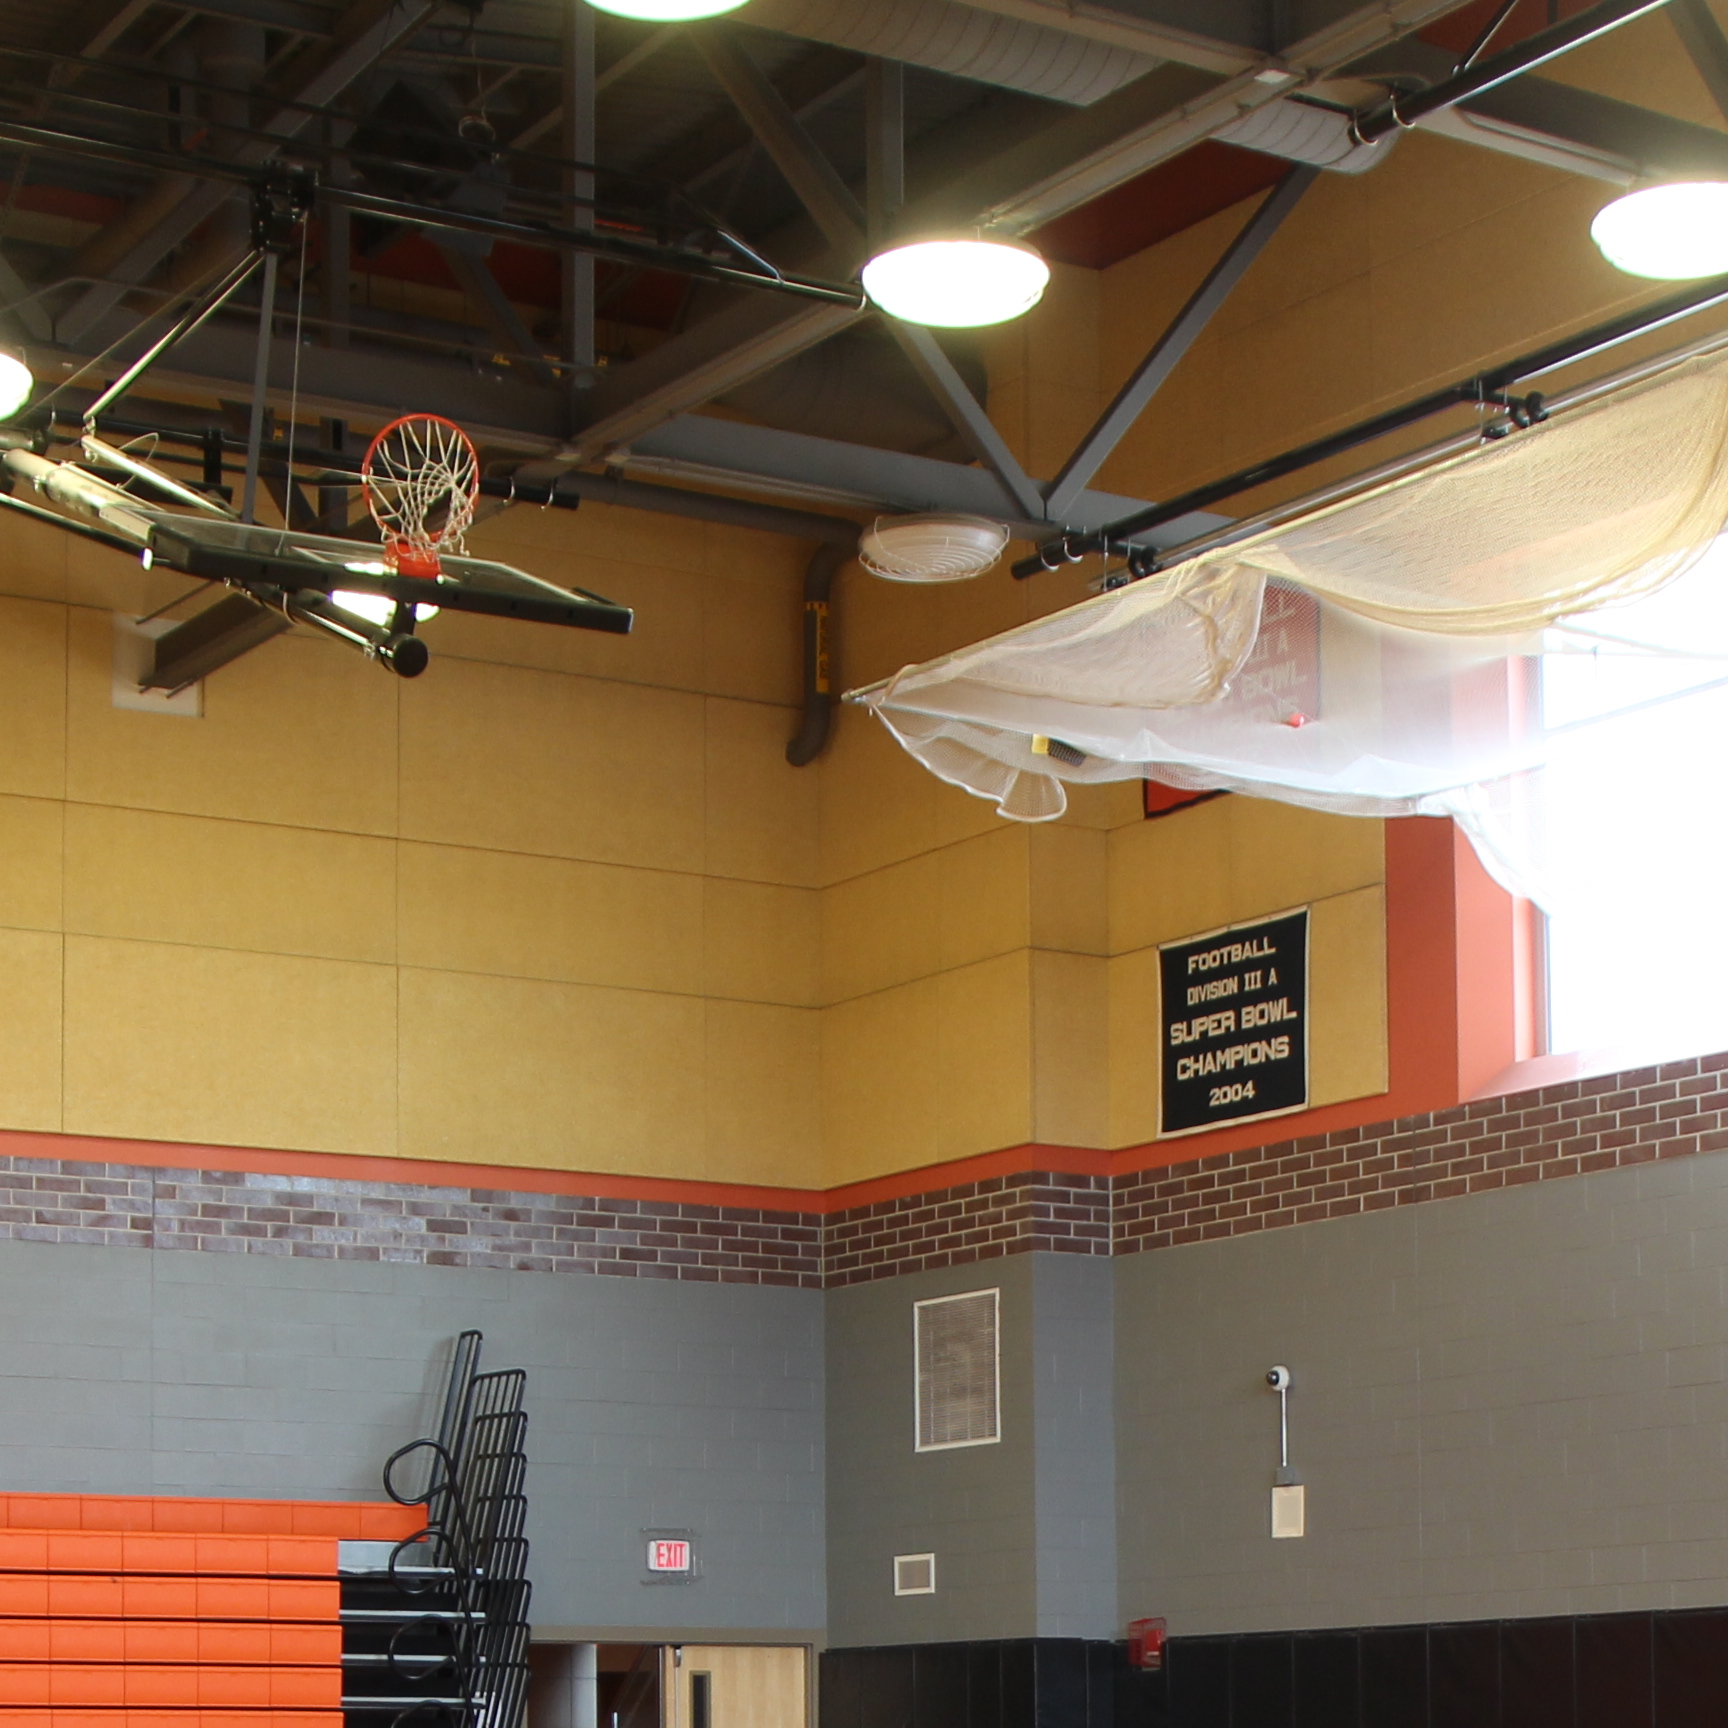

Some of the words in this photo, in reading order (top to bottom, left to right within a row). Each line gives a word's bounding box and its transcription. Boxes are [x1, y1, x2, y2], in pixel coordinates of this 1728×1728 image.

[1188, 936, 1276, 975] FOOTBALL
[1187, 976, 1238, 1006] DIVISION
[1244, 970, 1262, 992] III
[1268, 967, 1278, 986] A
[1170, 1009, 1235, 1045] SUPER
[1241, 997, 1297, 1029] BOWL
[1177, 1035, 1289, 1080] CHAMPIONS
[1209, 1080, 1255, 1107] 2004
[657, 1543, 685, 1567] EXIT
